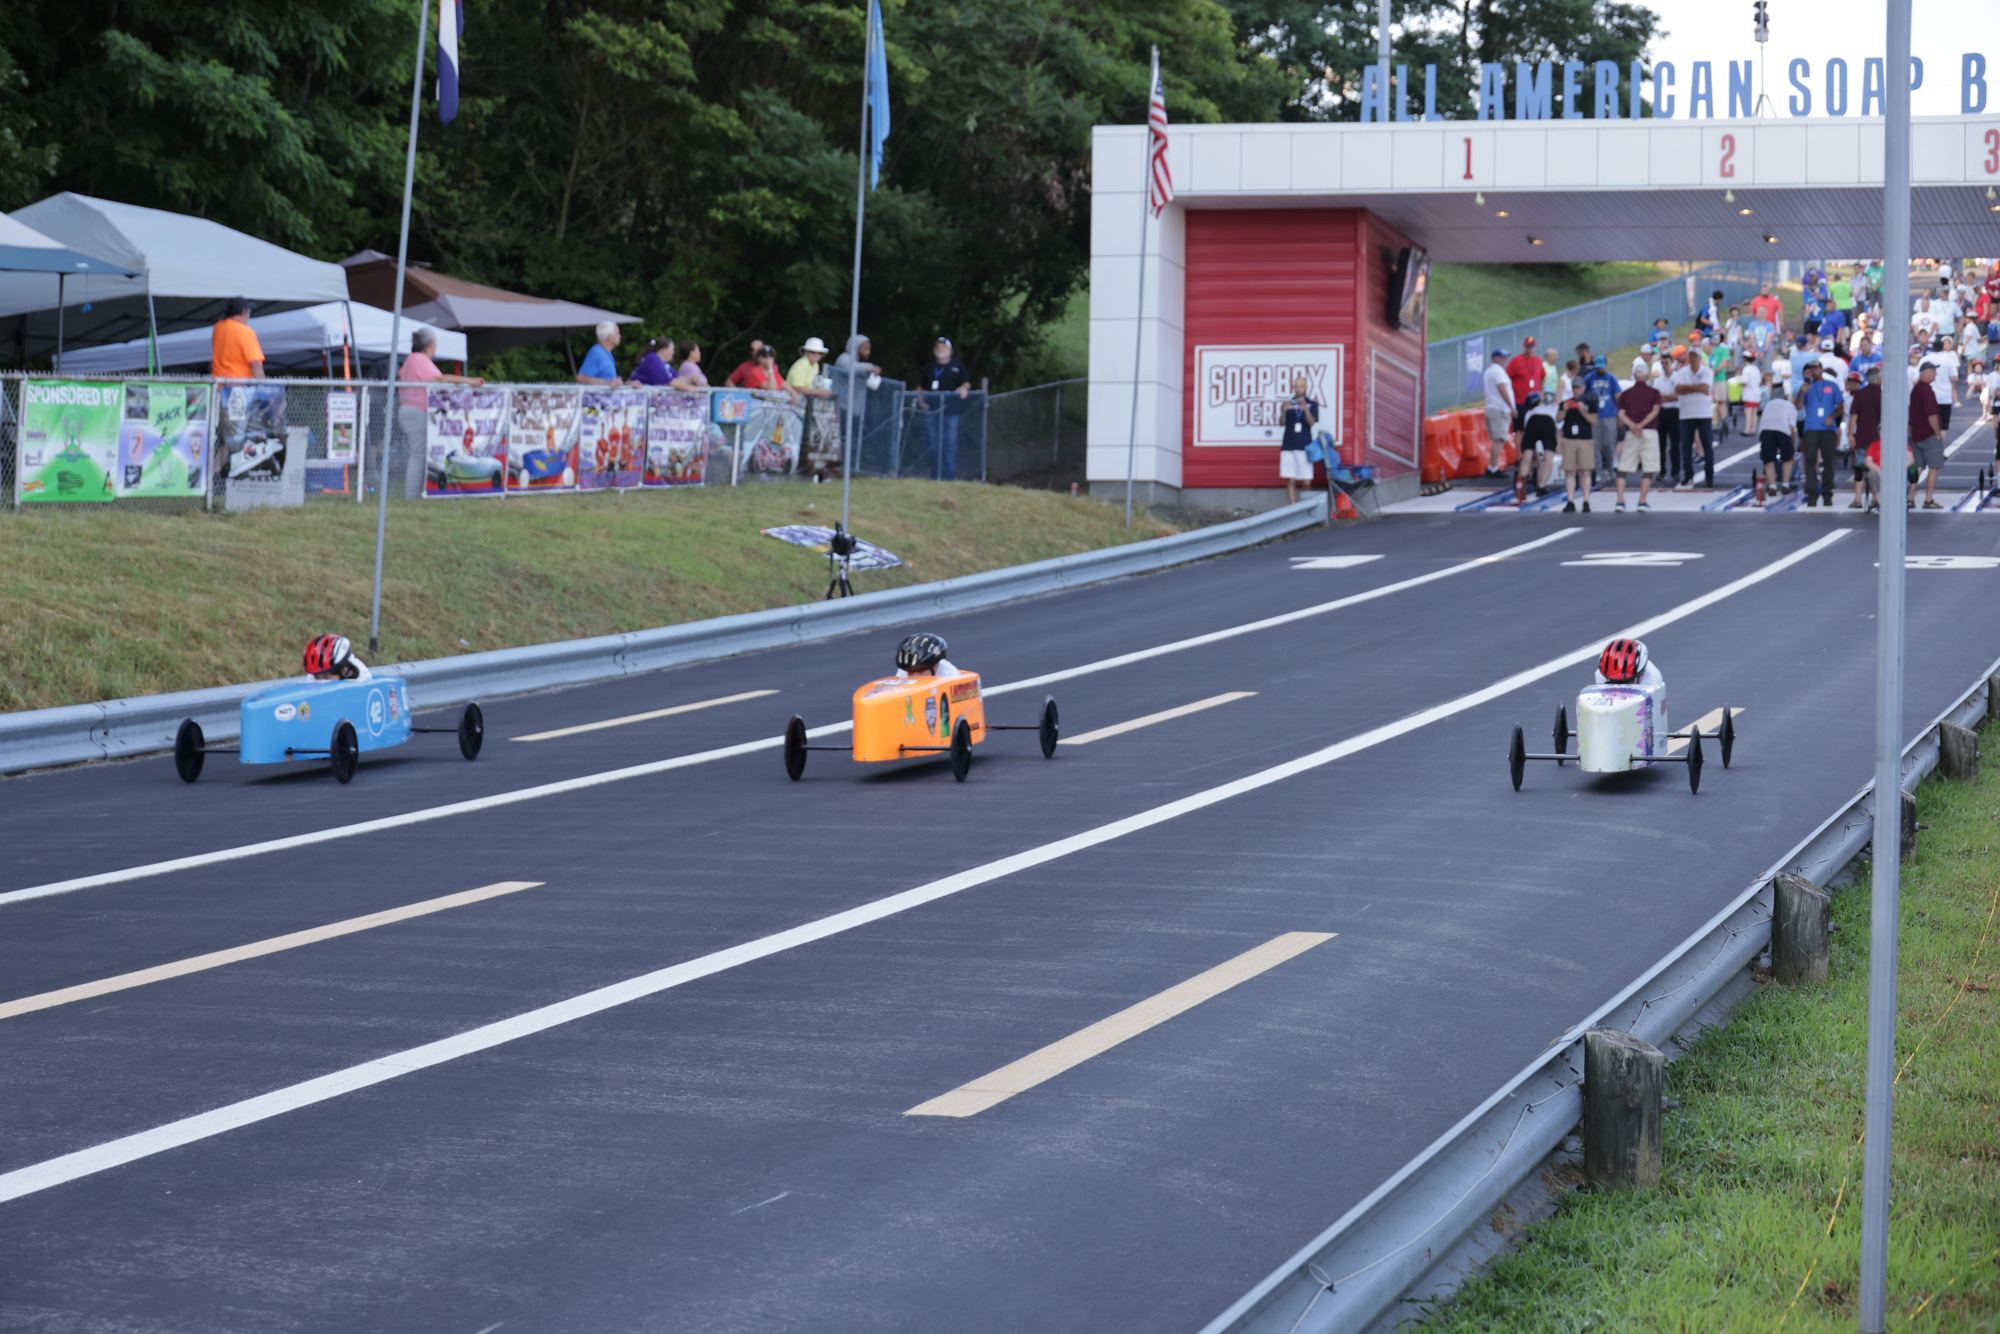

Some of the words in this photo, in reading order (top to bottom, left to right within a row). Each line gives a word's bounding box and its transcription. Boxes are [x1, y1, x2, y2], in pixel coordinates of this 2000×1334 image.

[1360, 63, 1443, 123] ALL
[1477, 60, 1753, 121] AMERICAN
[1961, 52, 1988, 115] B
[1463, 137, 1474, 180] 1
[1719, 133, 1736, 178] 2
[1984, 128, 2000, 175] 3
[27, 384, 101, 407] SPONSORED
[102, 387, 120, 407] BY
[1209, 364, 1274, 409] SOAP
[370, 700, 382, 723] 42
